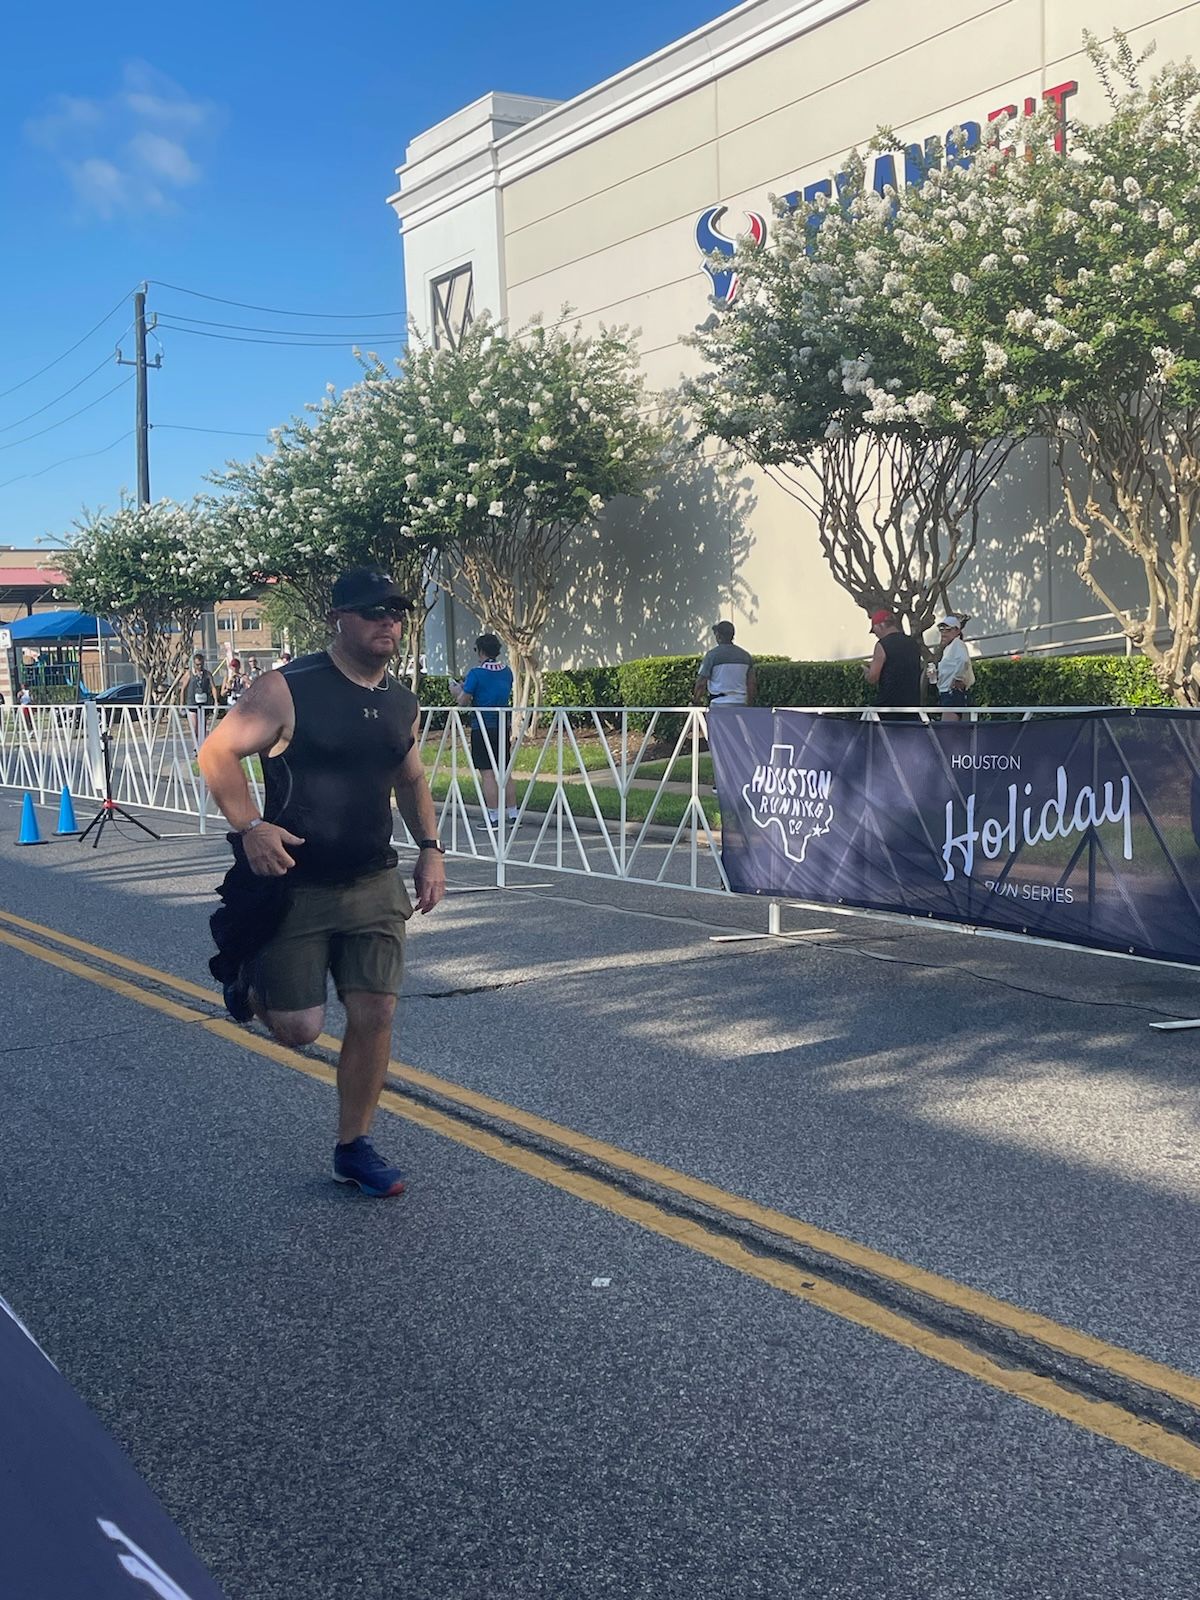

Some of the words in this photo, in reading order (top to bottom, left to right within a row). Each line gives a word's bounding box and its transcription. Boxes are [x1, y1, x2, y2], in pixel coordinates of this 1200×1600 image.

[951, 754, 1021, 771] HOUSTON
[752, 765, 832, 800] HOUSTON
[942, 765, 1133, 882] Holiday
[1022, 884, 1074, 904] SERIES
